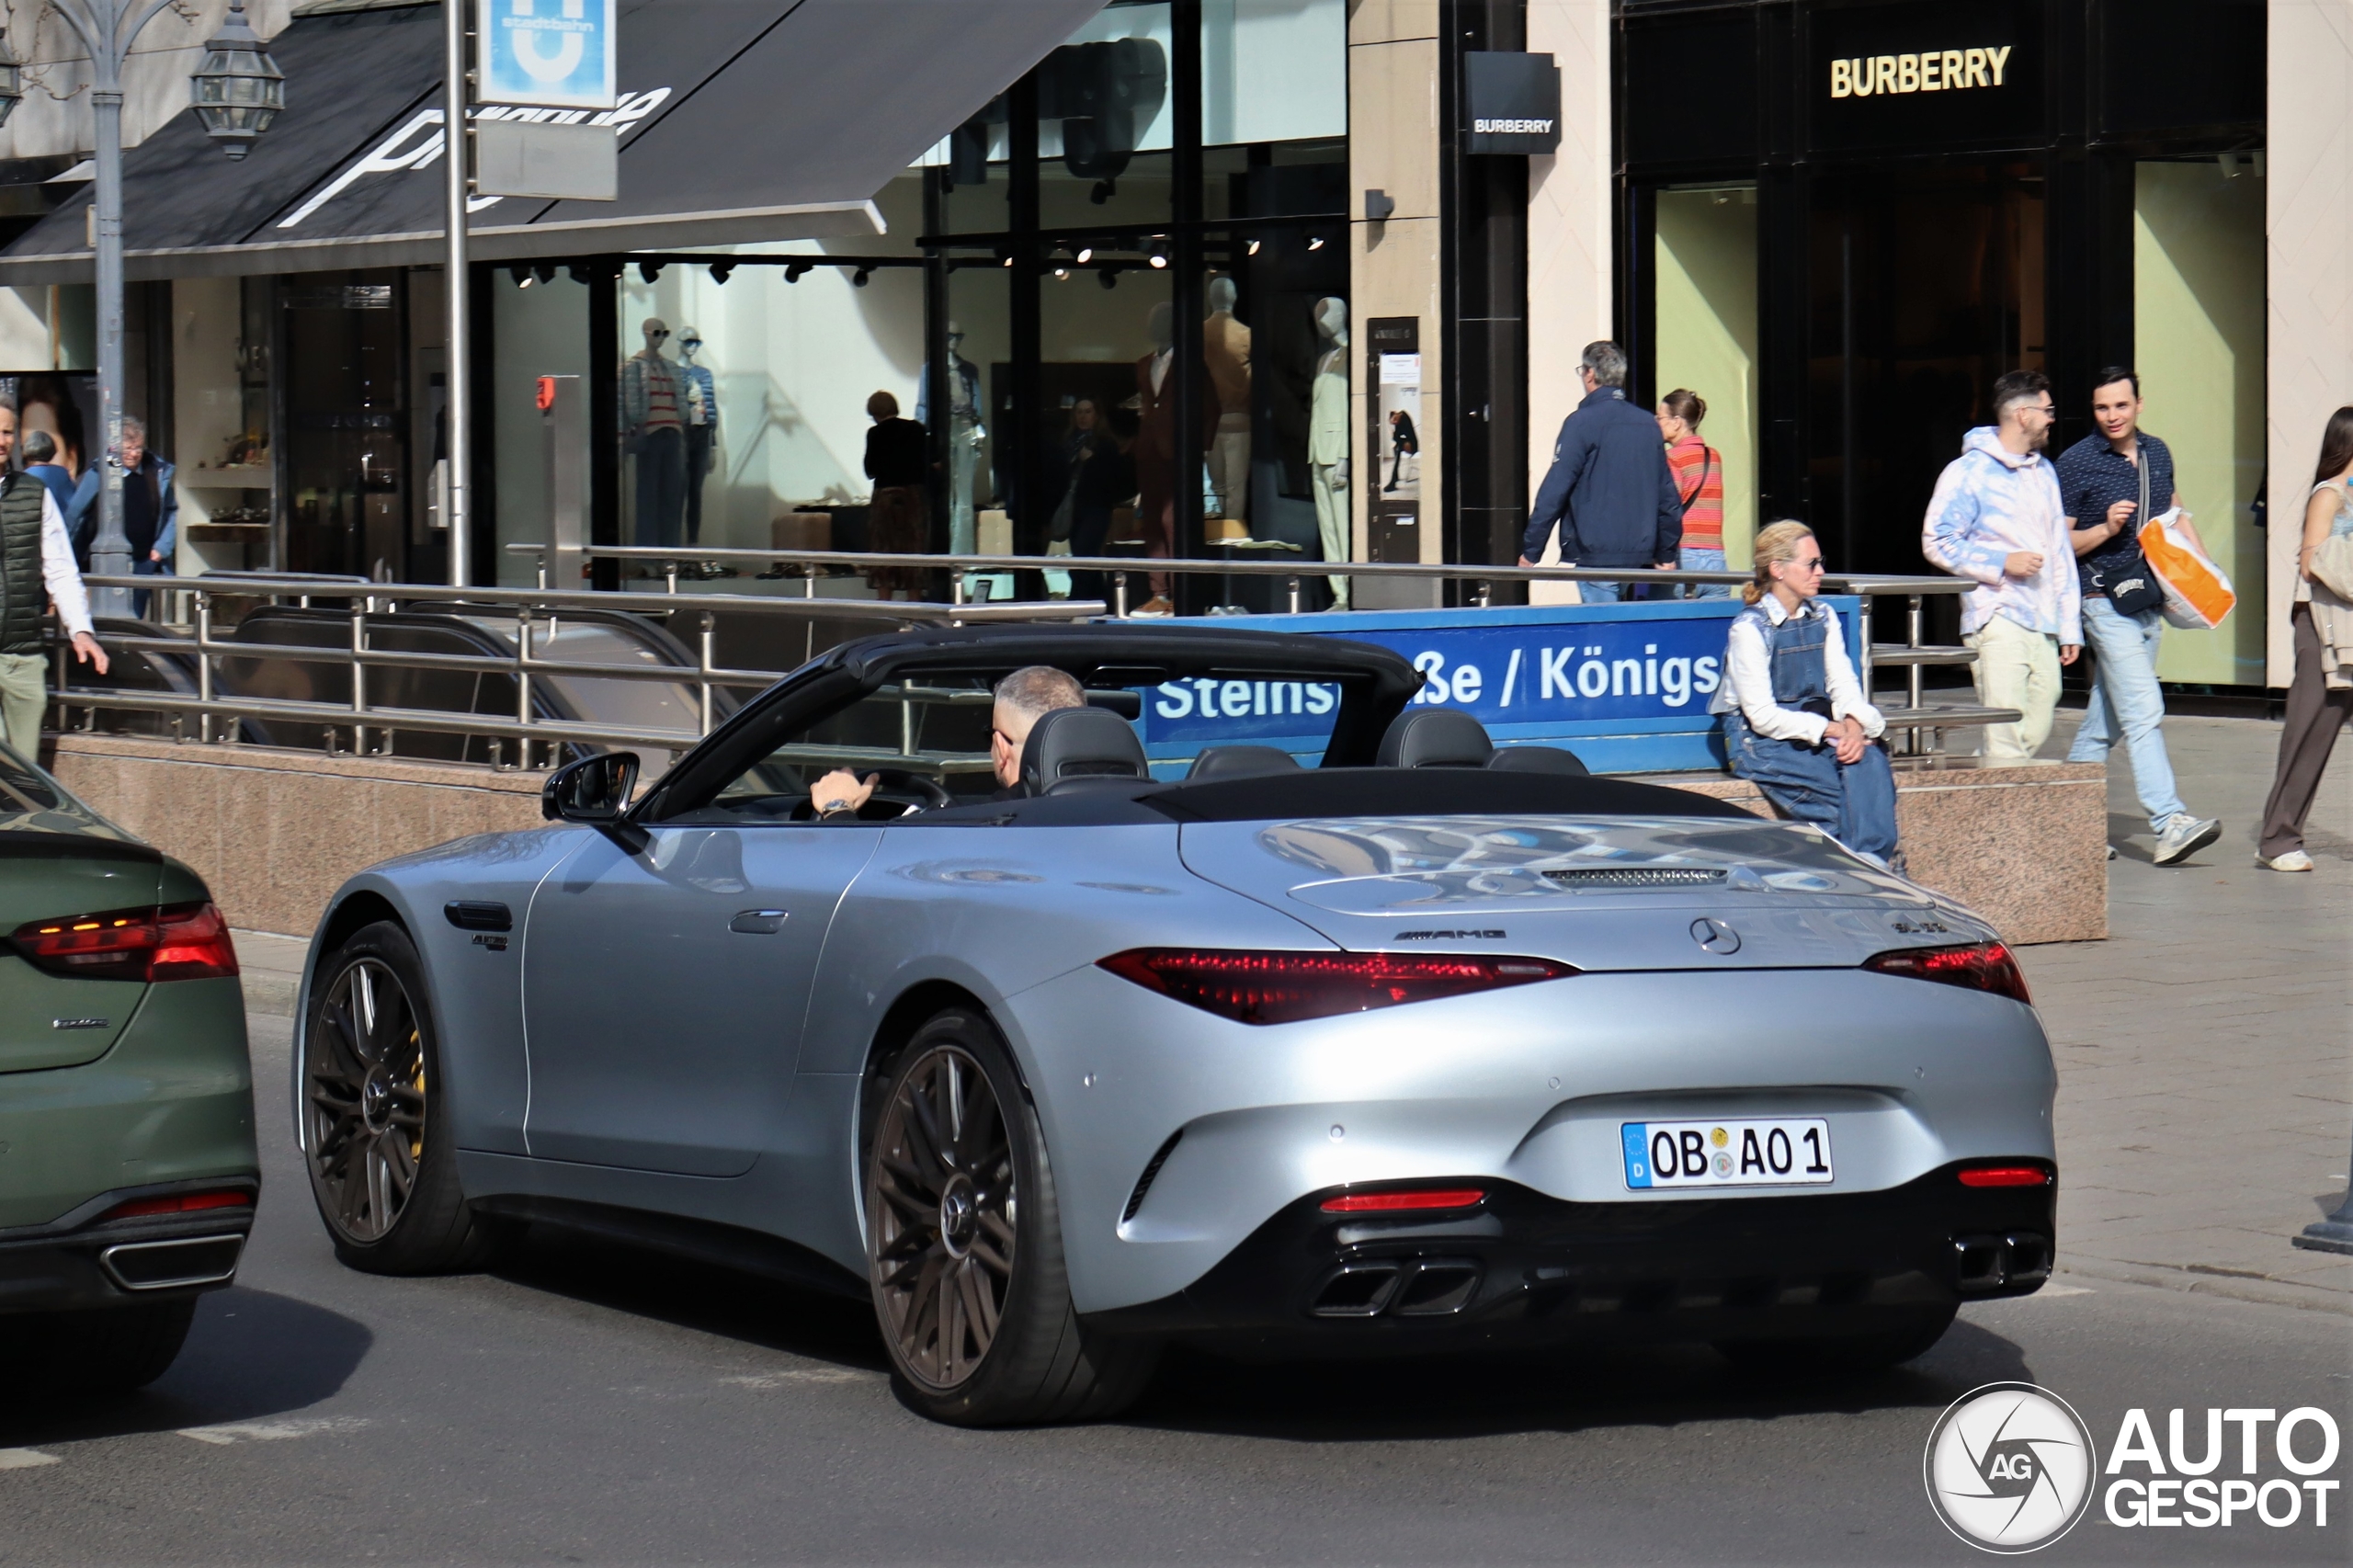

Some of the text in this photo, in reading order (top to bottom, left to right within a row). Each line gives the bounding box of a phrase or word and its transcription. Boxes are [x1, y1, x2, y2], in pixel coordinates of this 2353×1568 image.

[501, 17, 595, 32] stadtbahn
[1831, 46, 2011, 98] BURBERRY
[1474, 119, 1553, 133] BURBERRY
[1499, 648, 1522, 708] /
[1432, 930, 1507, 939] AMG
[1651, 1128, 1828, 1179] OB AO 1
[1633, 1163, 1644, 1178] D
